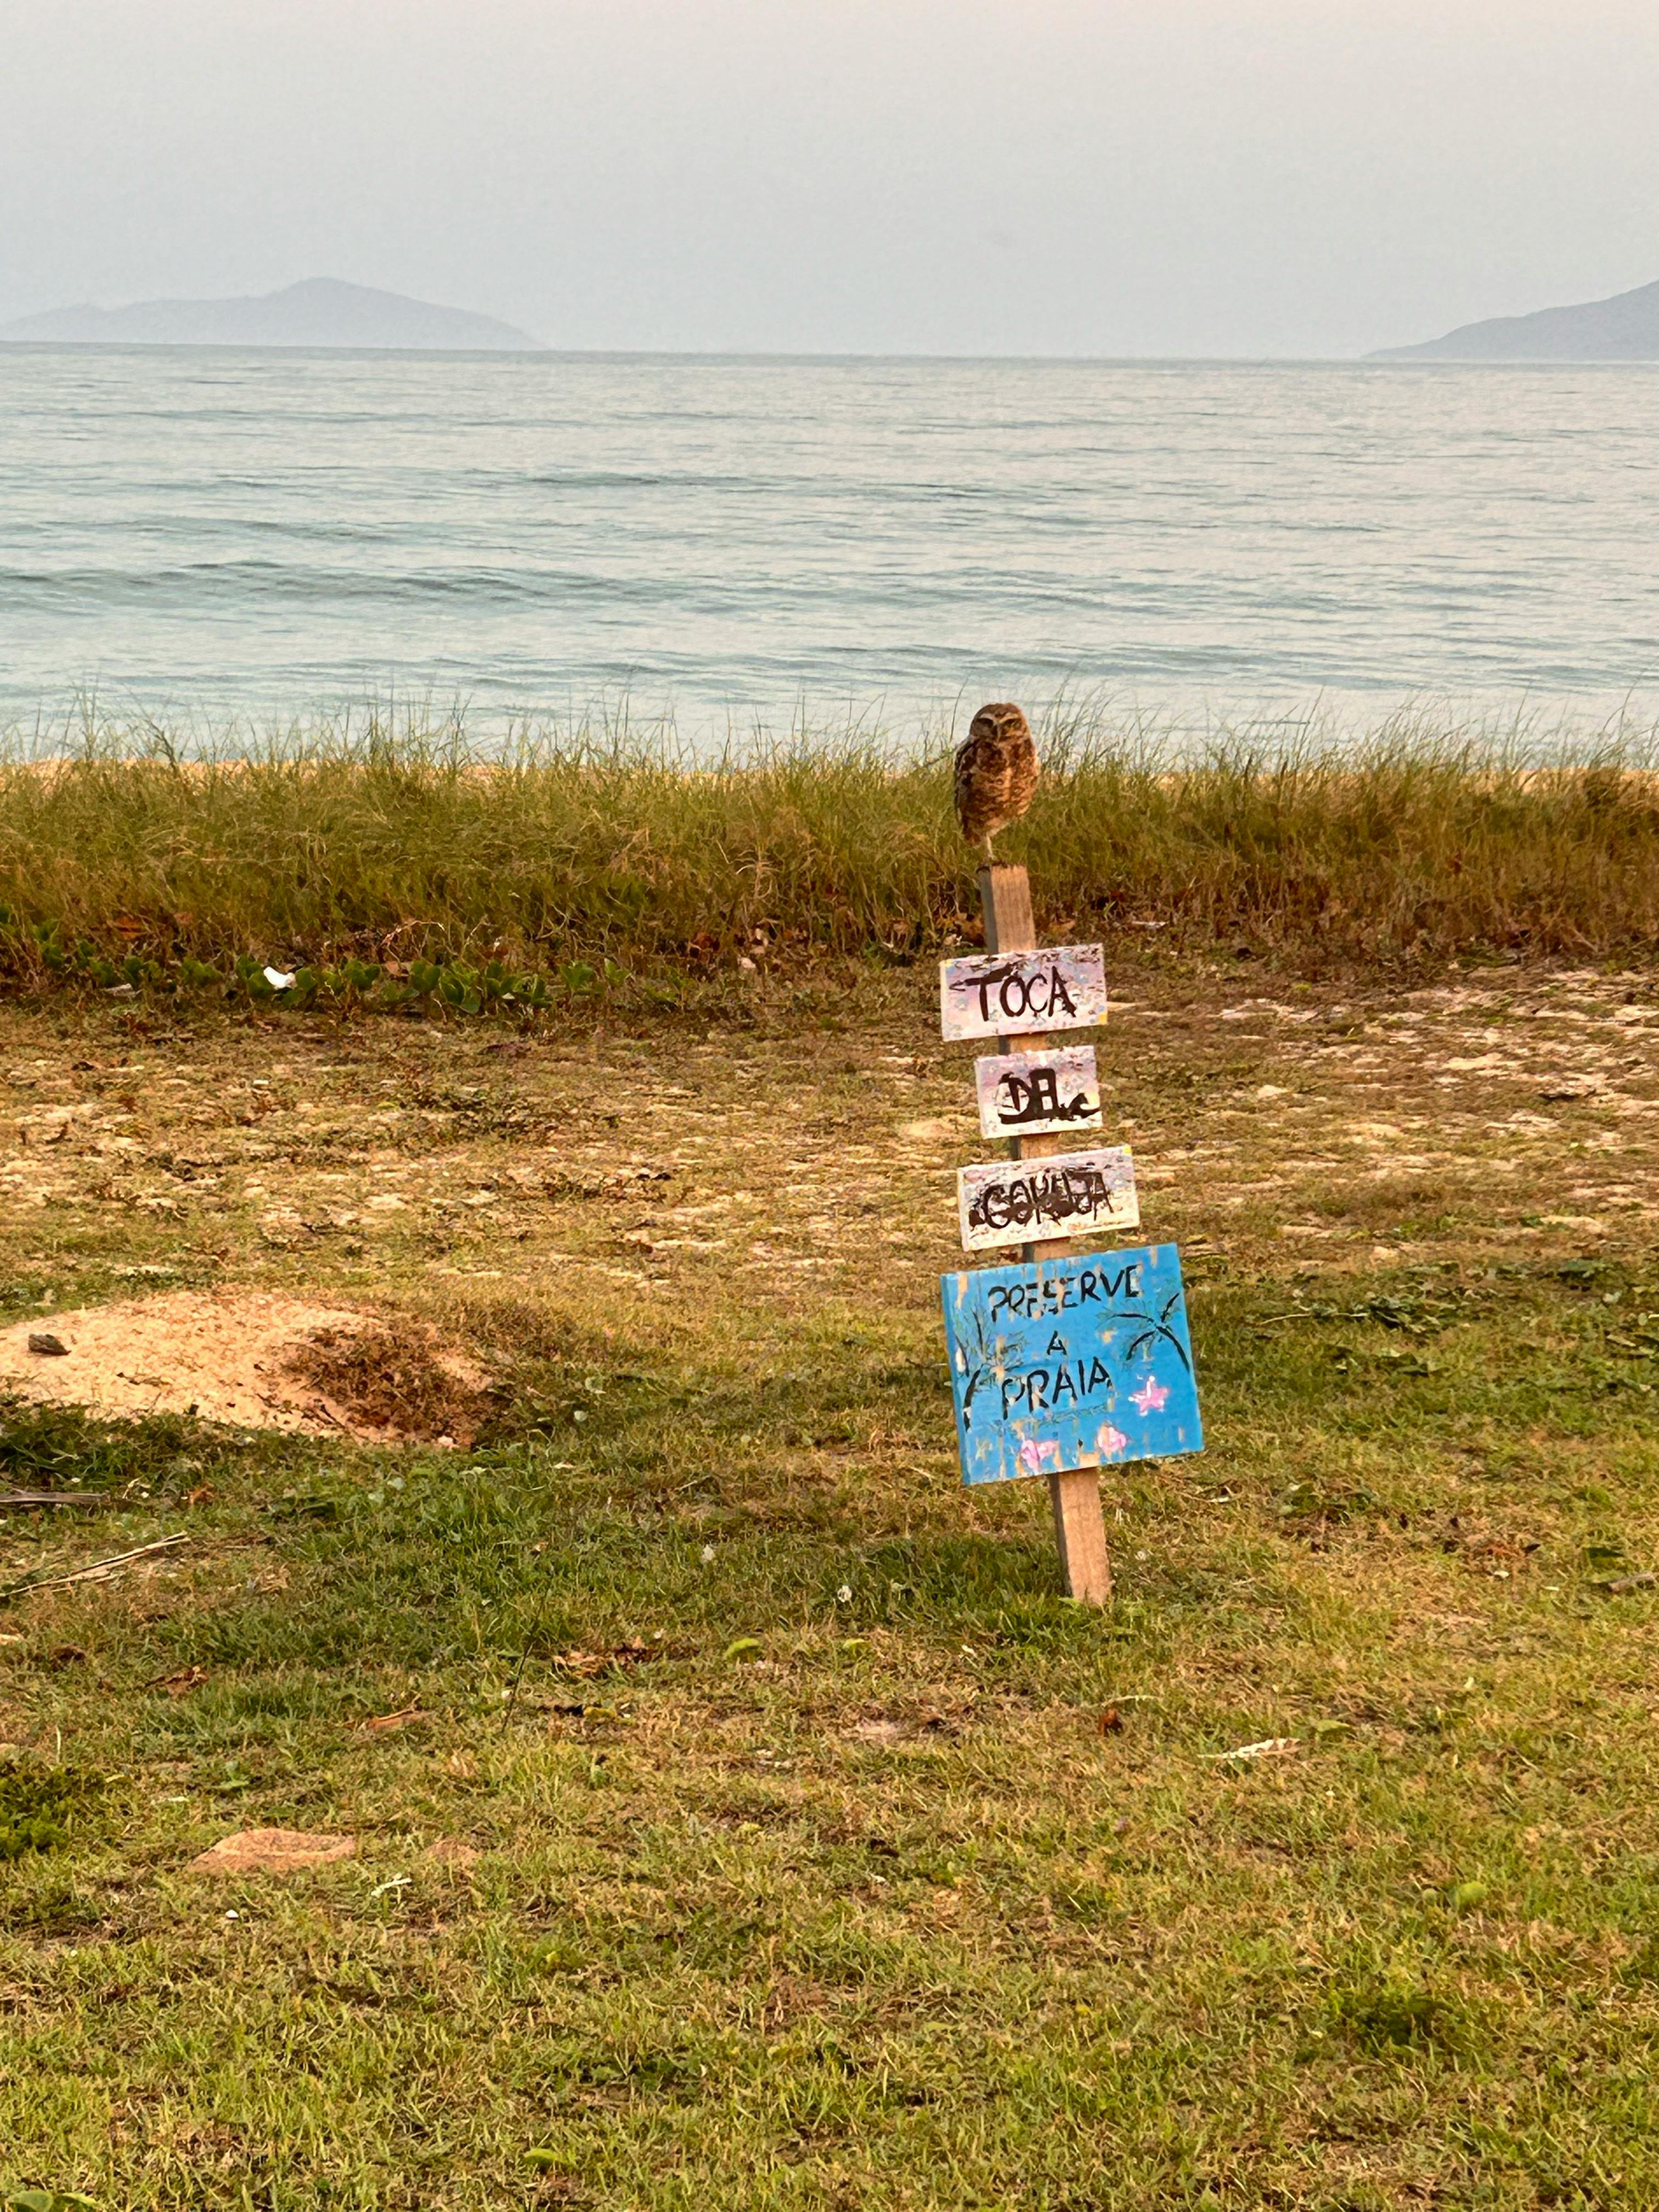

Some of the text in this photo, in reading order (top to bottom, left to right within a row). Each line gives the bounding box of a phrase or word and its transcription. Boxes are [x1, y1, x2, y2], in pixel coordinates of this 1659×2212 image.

[950, 962, 1077, 1022] TOCA
[988, 1264, 1144, 1322] PRESERVE
[1046, 1330, 1068, 1356] A
[1001, 1356, 1113, 1420] PRAIA
